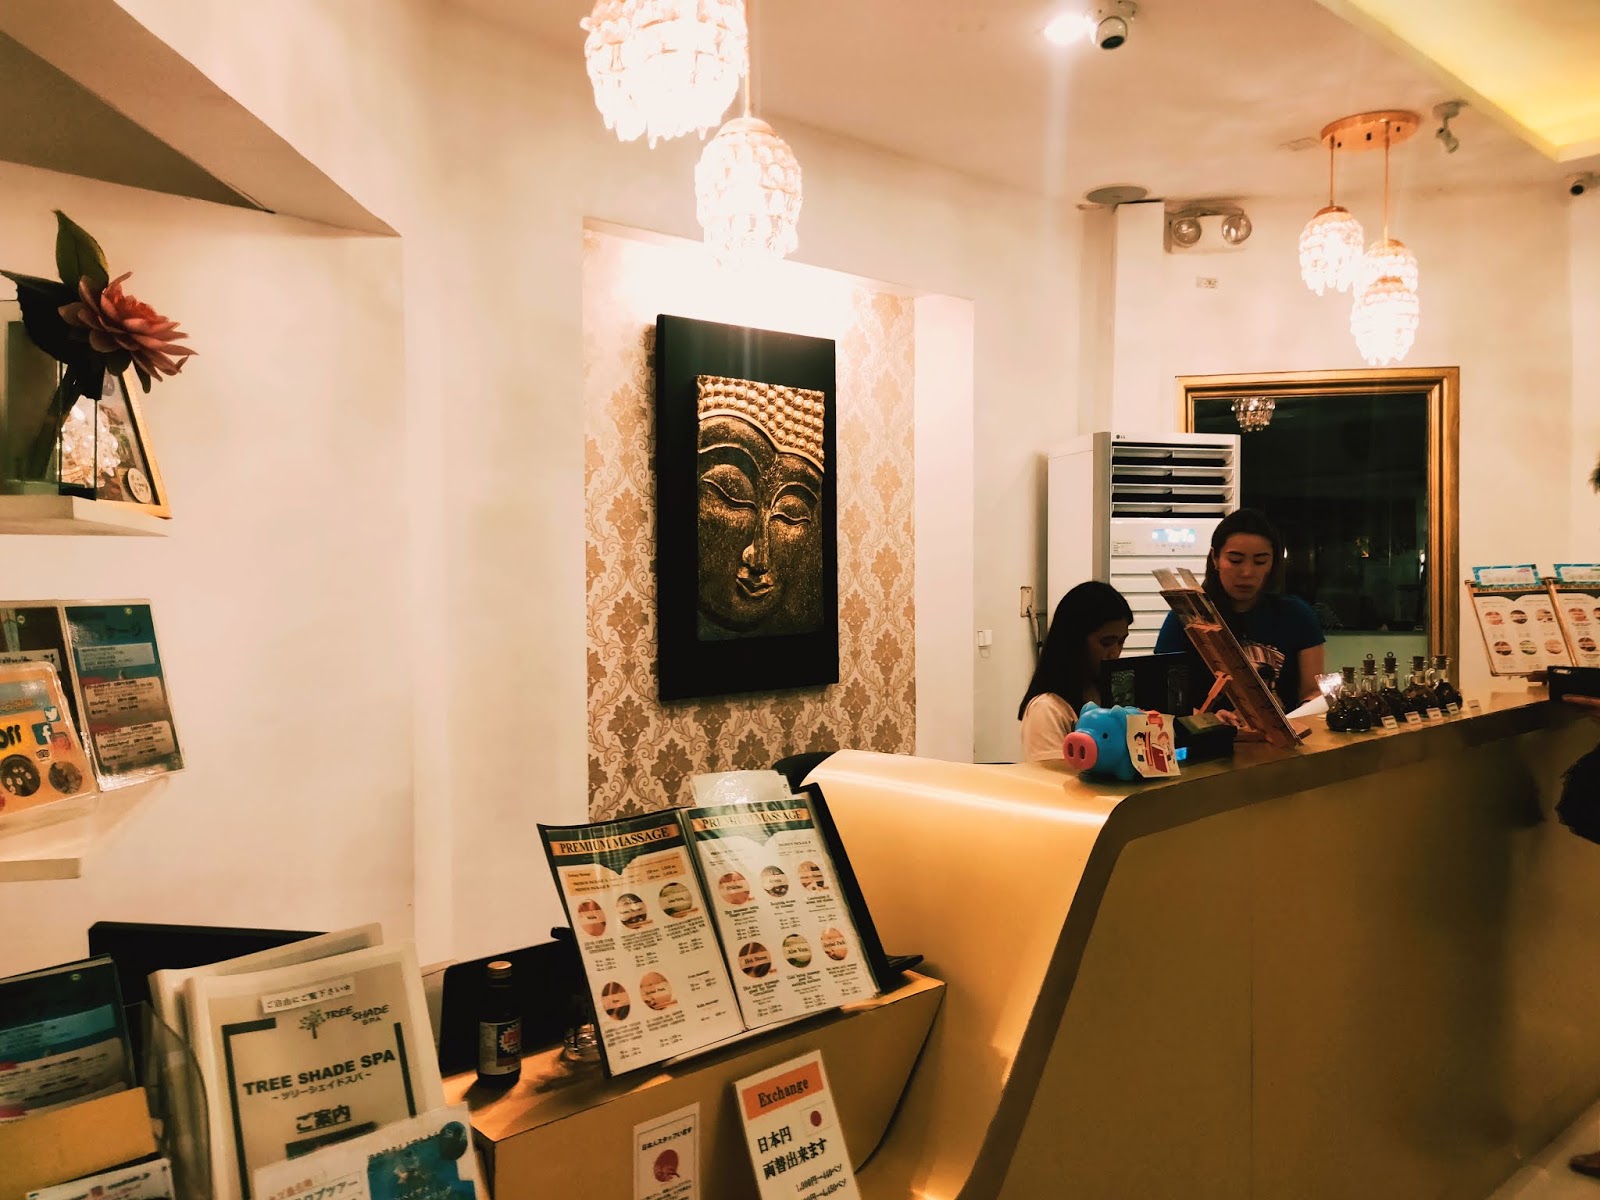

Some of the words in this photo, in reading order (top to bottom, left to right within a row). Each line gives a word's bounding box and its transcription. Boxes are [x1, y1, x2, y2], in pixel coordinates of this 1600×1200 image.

[759, 810, 802, 823] MASSAGE
[559, 840, 612, 854] PREMIUM
[612, 826, 670, 848] MASSAGE
[323, 1005, 354, 1020] TREE
[351, 1004, 390, 1021] SHADE
[242, 1074, 294, 1096] TREE
[297, 1060, 356, 1085] SHADE
[360, 1049, 396, 1069] SPA
[758, 1079, 809, 1108] Exchange
[295, 1104, 352, 1131] ご案内
[757, 1125, 793, 1154] 日本円
[762, 1137, 827, 1180] 両替出来ます
